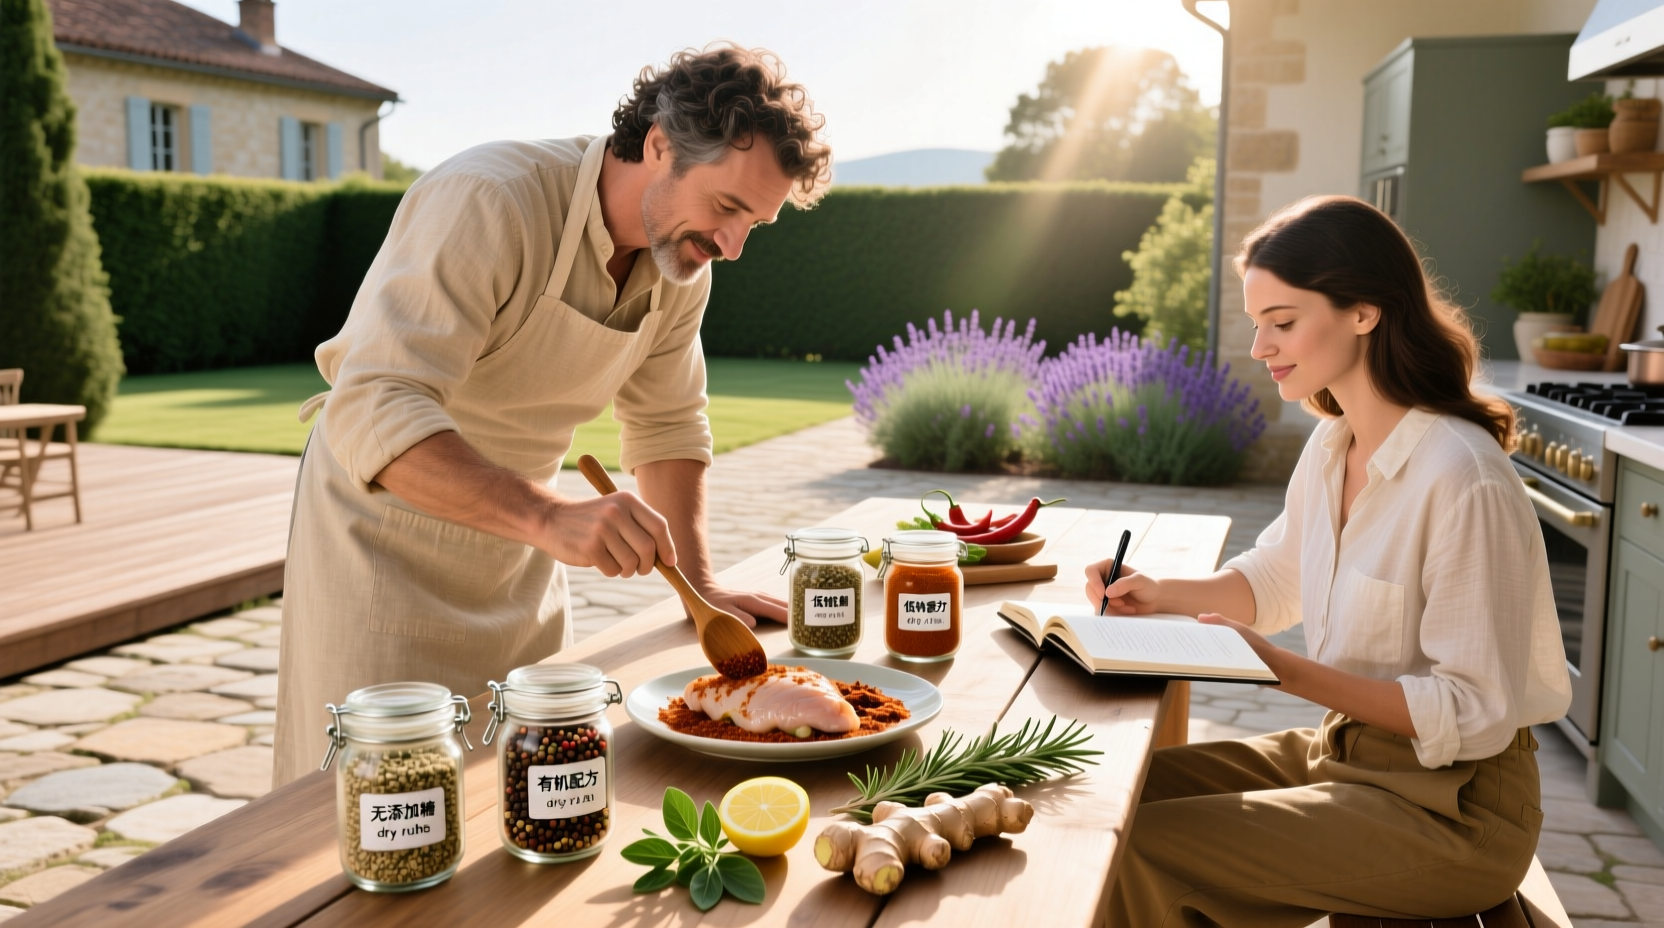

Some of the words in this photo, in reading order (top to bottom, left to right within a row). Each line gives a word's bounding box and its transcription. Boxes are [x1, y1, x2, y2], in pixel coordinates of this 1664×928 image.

[370, 800, 436, 822] 无添加糖
[377, 826, 397, 841] dry
